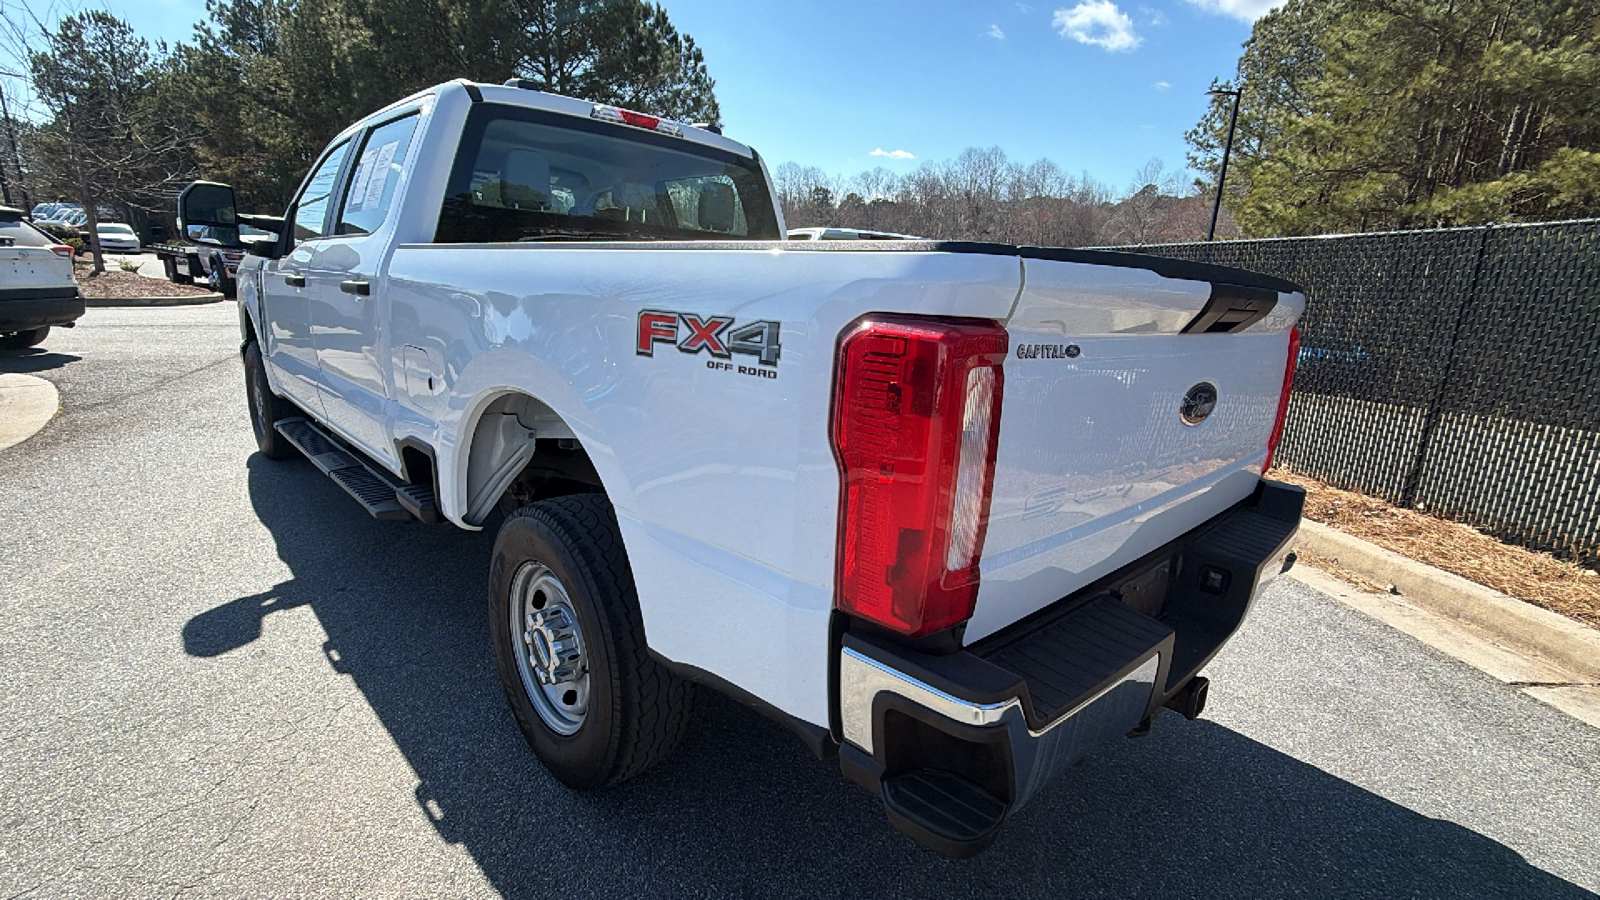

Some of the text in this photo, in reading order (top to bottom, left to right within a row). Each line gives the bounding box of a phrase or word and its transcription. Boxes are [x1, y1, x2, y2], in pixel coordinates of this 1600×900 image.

[635, 308, 782, 368] FX4
[1016, 343, 1066, 360] CAPITAL
[706, 360, 778, 380] OFF ROAD
